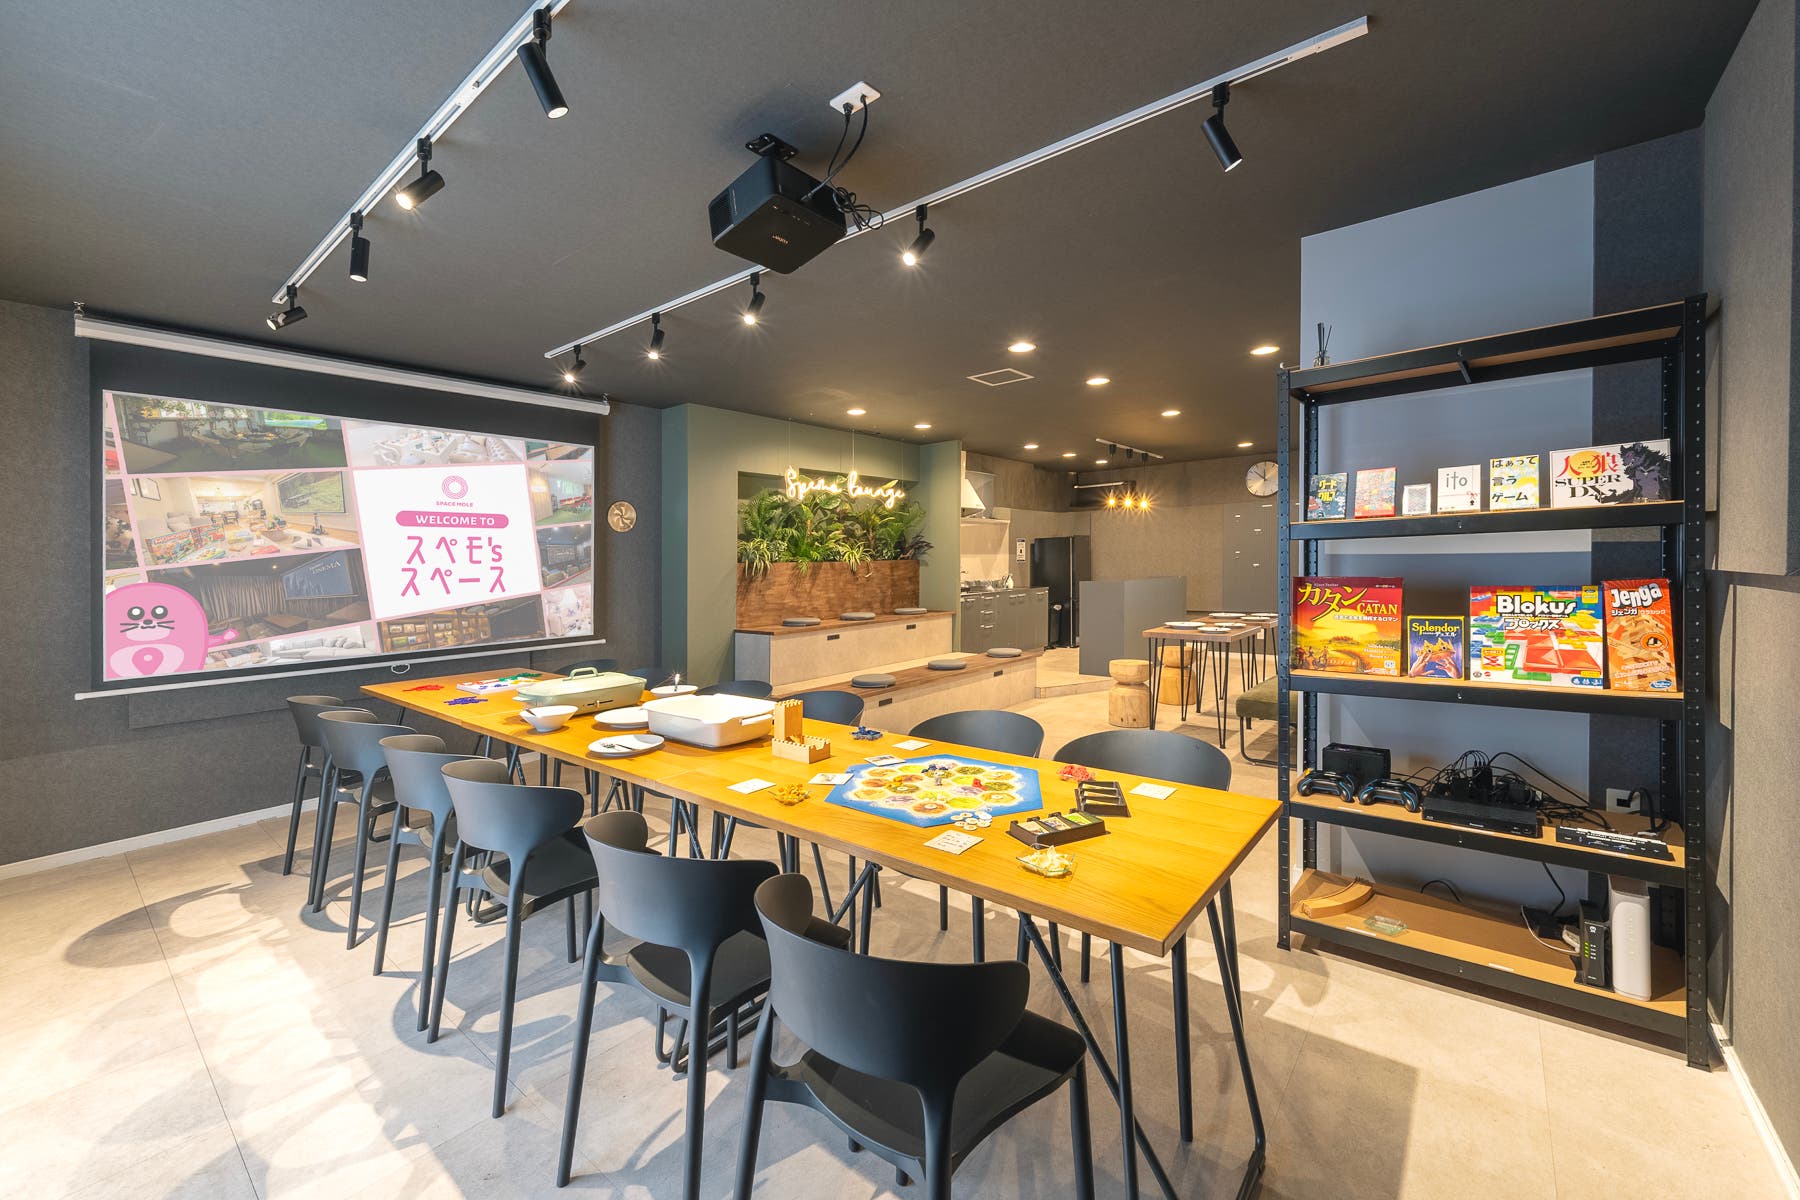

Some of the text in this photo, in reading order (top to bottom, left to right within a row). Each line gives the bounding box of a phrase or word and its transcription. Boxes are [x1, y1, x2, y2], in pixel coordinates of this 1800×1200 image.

[1491, 456, 1537, 468] はぁって
[1557, 451, 1618, 478] 人狼
[1446, 472, 1467, 490] ito
[1492, 475, 1517, 486] 言う
[1555, 474, 1621, 487] SUPER
[1492, 492, 1528, 502] ゲーム
[1569, 486, 1607, 498] DX
[415, 515, 495, 526] WELCOME TO
[406, 536, 503, 565] スペモ's
[401, 566, 506, 597] スペース
[1297, 583, 1368, 621] カタン
[1610, 583, 1663, 608] Jenga
[1356, 603, 1398, 615] CATAN
[1497, 595, 1577, 616] Blokus
[1412, 621, 1460, 635] Splendor
[1504, 618, 1562, 632] ブロックス
